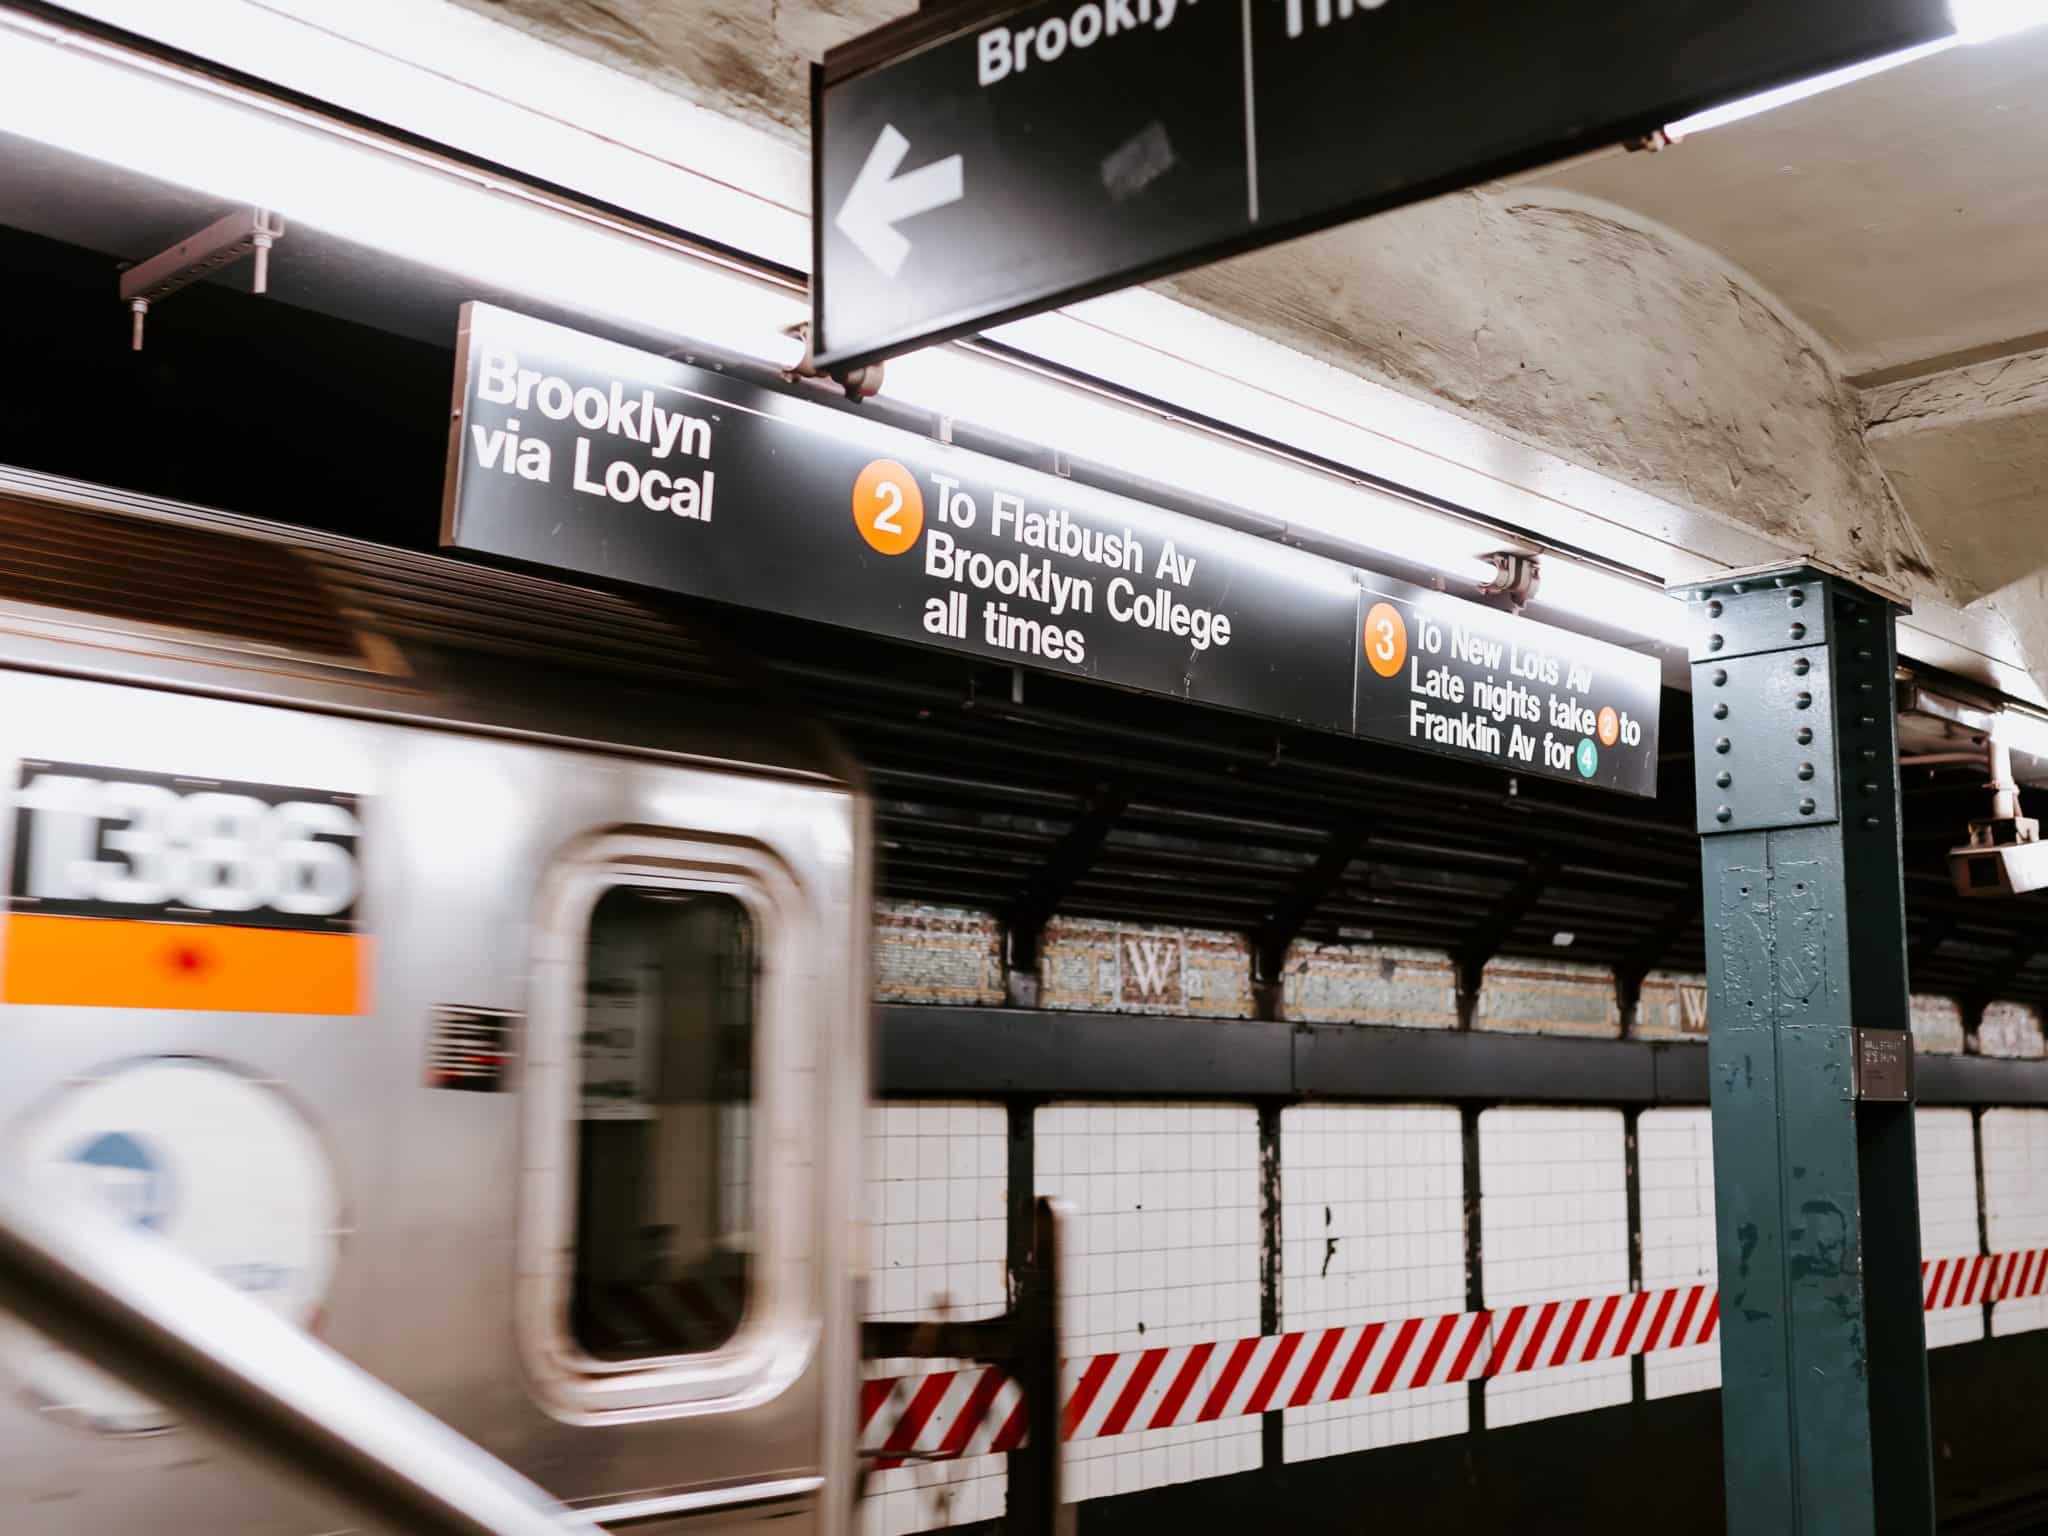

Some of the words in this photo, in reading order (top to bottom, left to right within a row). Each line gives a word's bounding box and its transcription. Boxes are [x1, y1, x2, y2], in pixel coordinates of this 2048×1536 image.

[978, 0, 1198, 87] Brooky
[477, 345, 712, 460] Brooklyn
[471, 418, 551, 483] via
[573, 436, 715, 523] Local
[873, 481, 903, 535] 2
[929, 473, 977, 529] To
[991, 490, 1143, 574] Flatbush
[1155, 539, 1197, 587] Av
[923, 591, 968, 640] all
[983, 601, 1086, 664] times
[925, 530, 1093, 616] Brooklyn
[1106, 577, 1232, 651] College
[1375, 619, 1395, 661] 3
[1412, 611, 1442, 654] To
[1450, 623, 1503, 670] New
[1510, 640, 1559, 686] Lots
[1566, 660, 1593, 694] Av
[1410, 655, 1465, 704] Late
[1472, 675, 1541, 723] nights
[1549, 693, 1597, 736] take
[1619, 711, 1641, 747] to
[1410, 700, 1501, 755] Franklin
[1507, 724, 1536, 762] Av
[1543, 732, 1574, 771] for
[1126, 941, 1177, 998] W
